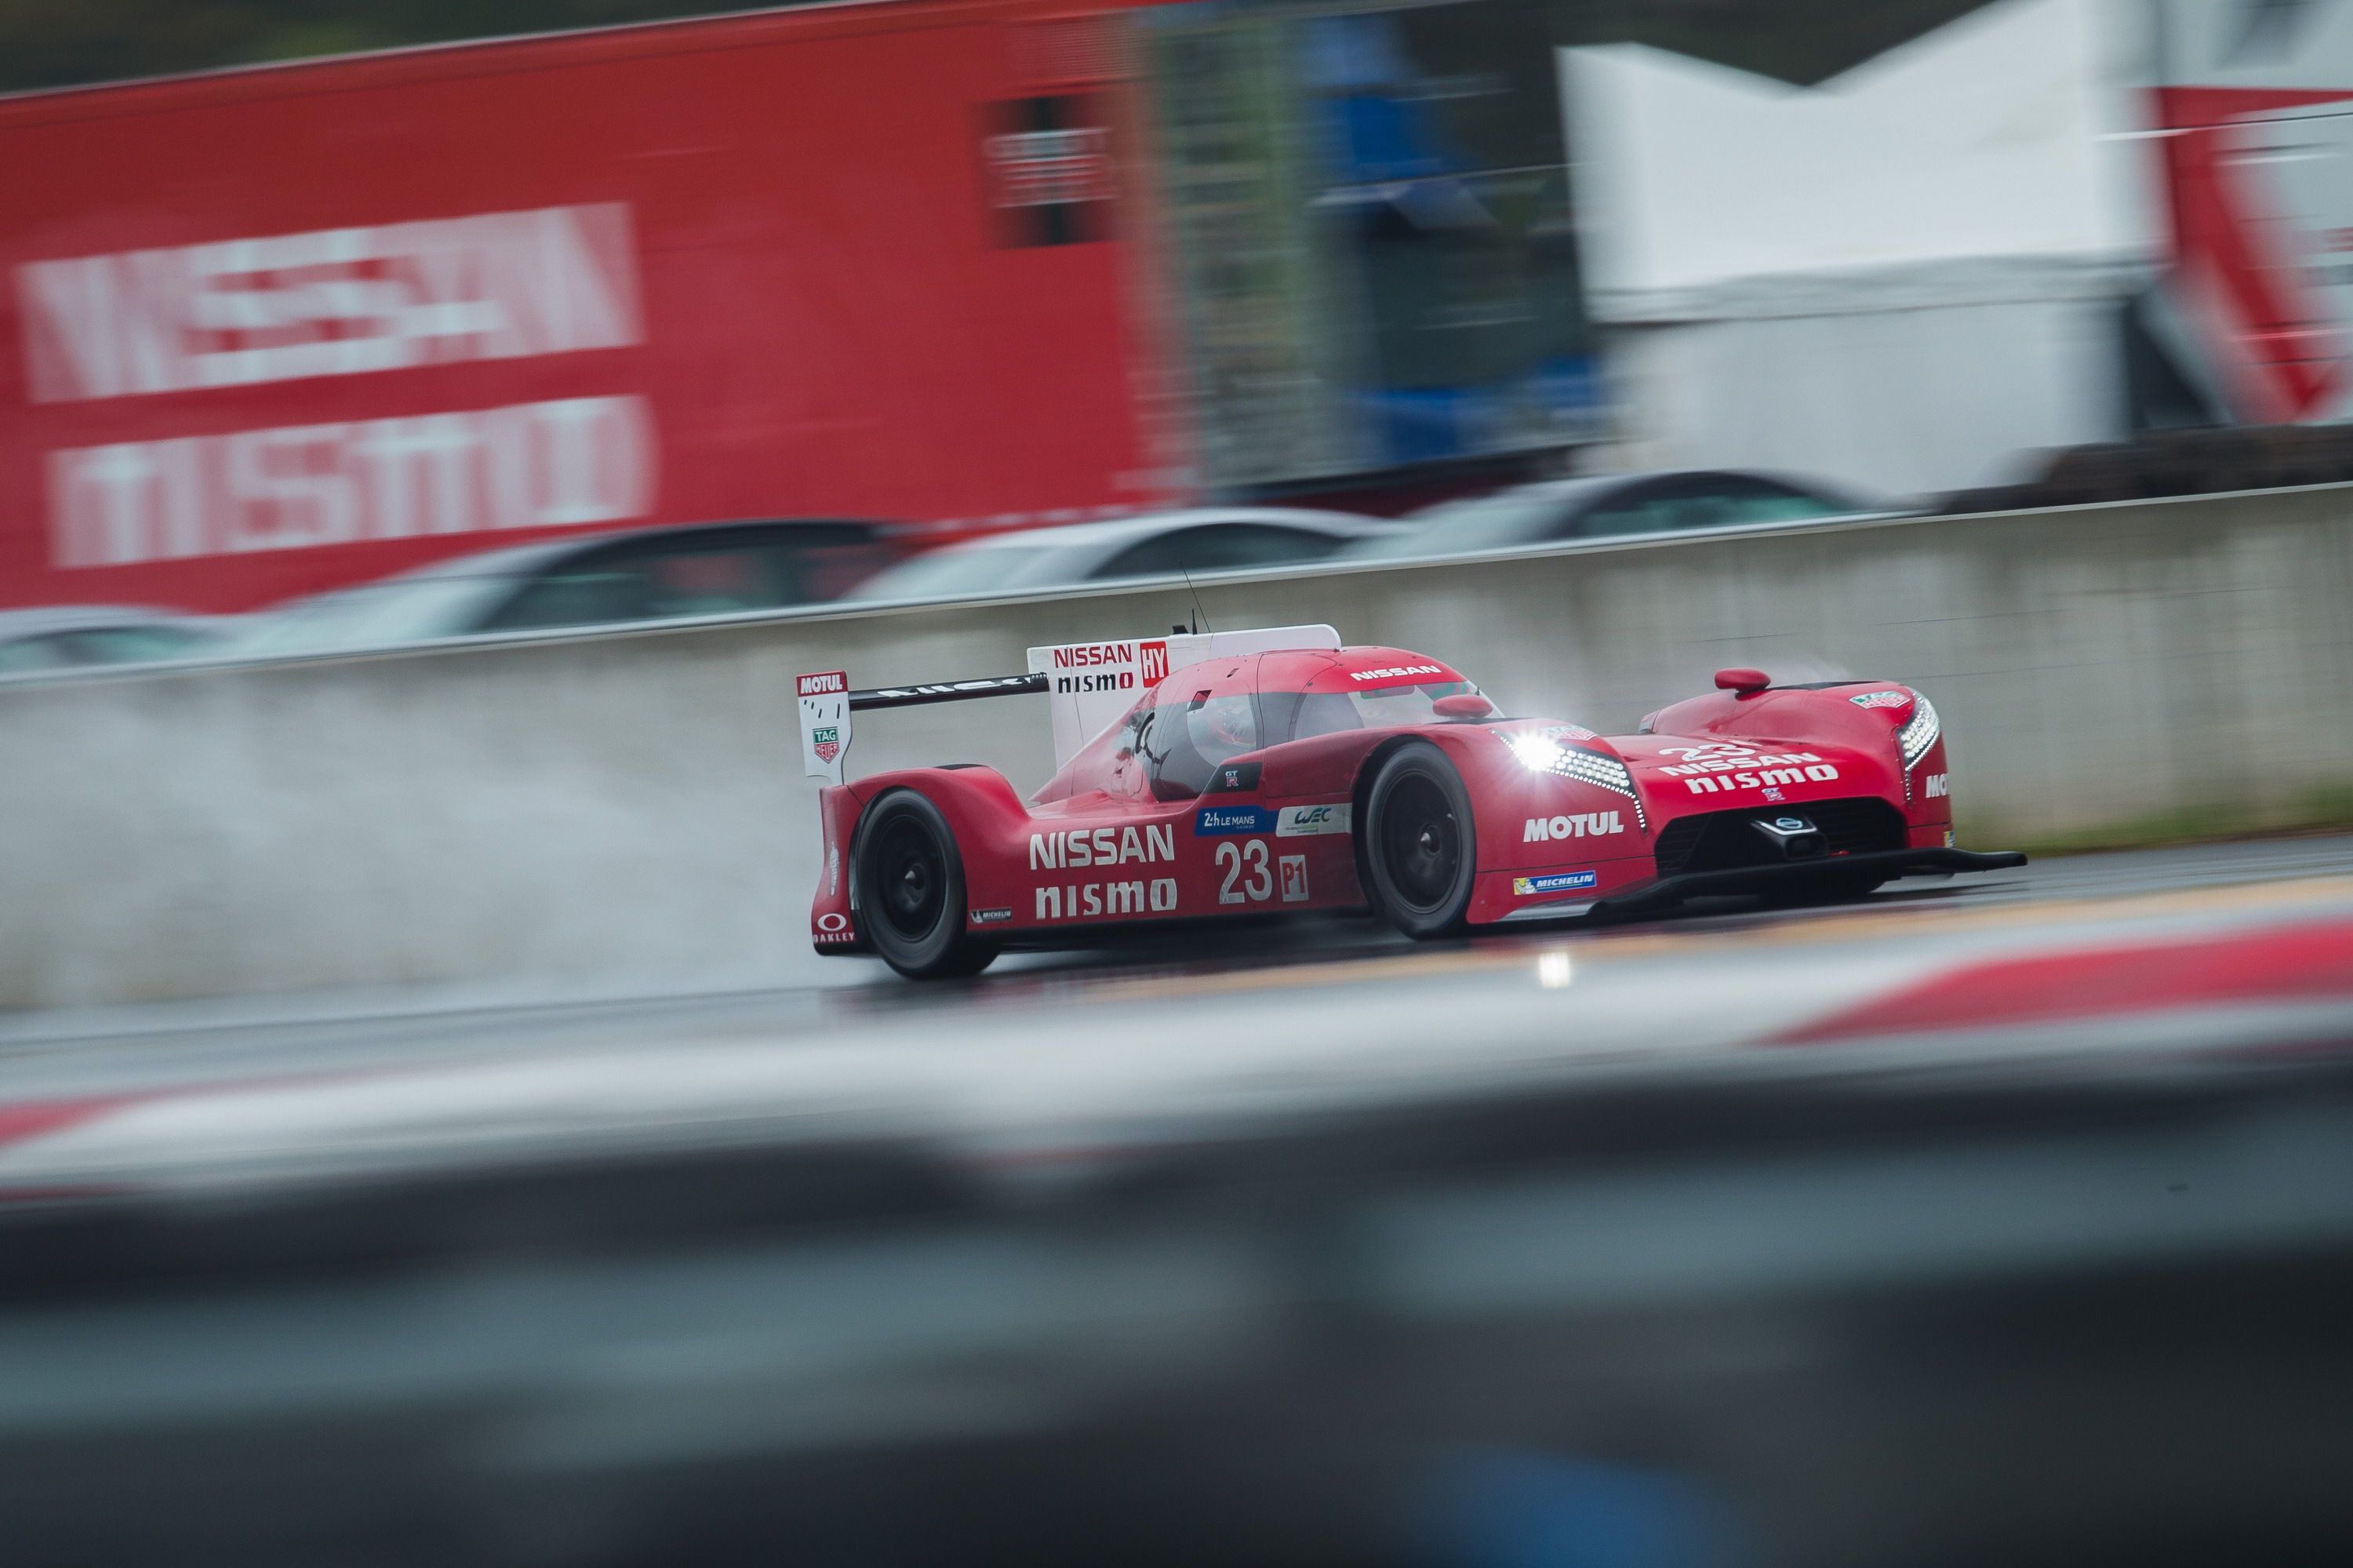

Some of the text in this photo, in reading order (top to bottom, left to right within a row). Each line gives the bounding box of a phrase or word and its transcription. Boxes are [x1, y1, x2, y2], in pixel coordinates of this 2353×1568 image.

[1053, 644, 1133, 668] NISSAN
[1141, 648, 1166, 679] HY
[800, 675, 842, 694] MOTUL
[1058, 672, 1134, 694] nismo
[1350, 665, 1442, 681] NISSAN
[815, 729, 837, 742] TAG
[816, 743, 838, 761] HEUER
[1659, 744, 1756, 762] 23
[1659, 752, 1822, 777] NISSAN
[1684, 764, 1838, 795] nismo
[1926, 773, 1948, 798] MO
[1220, 817, 1231, 826] LE
[1231, 816, 1255, 825] MANS
[1295, 807, 1331, 824] WEC
[1523, 810, 1624, 842] MOTUL
[1030, 824, 1175, 871] NISSAN
[1215, 839, 1273, 904] 23
[1282, 860, 1305, 895] P1
[1537, 874, 1593, 887] MICHELIN
[1035, 879, 1177, 920] nismo
[813, 932, 855, 943] OAKLEY
